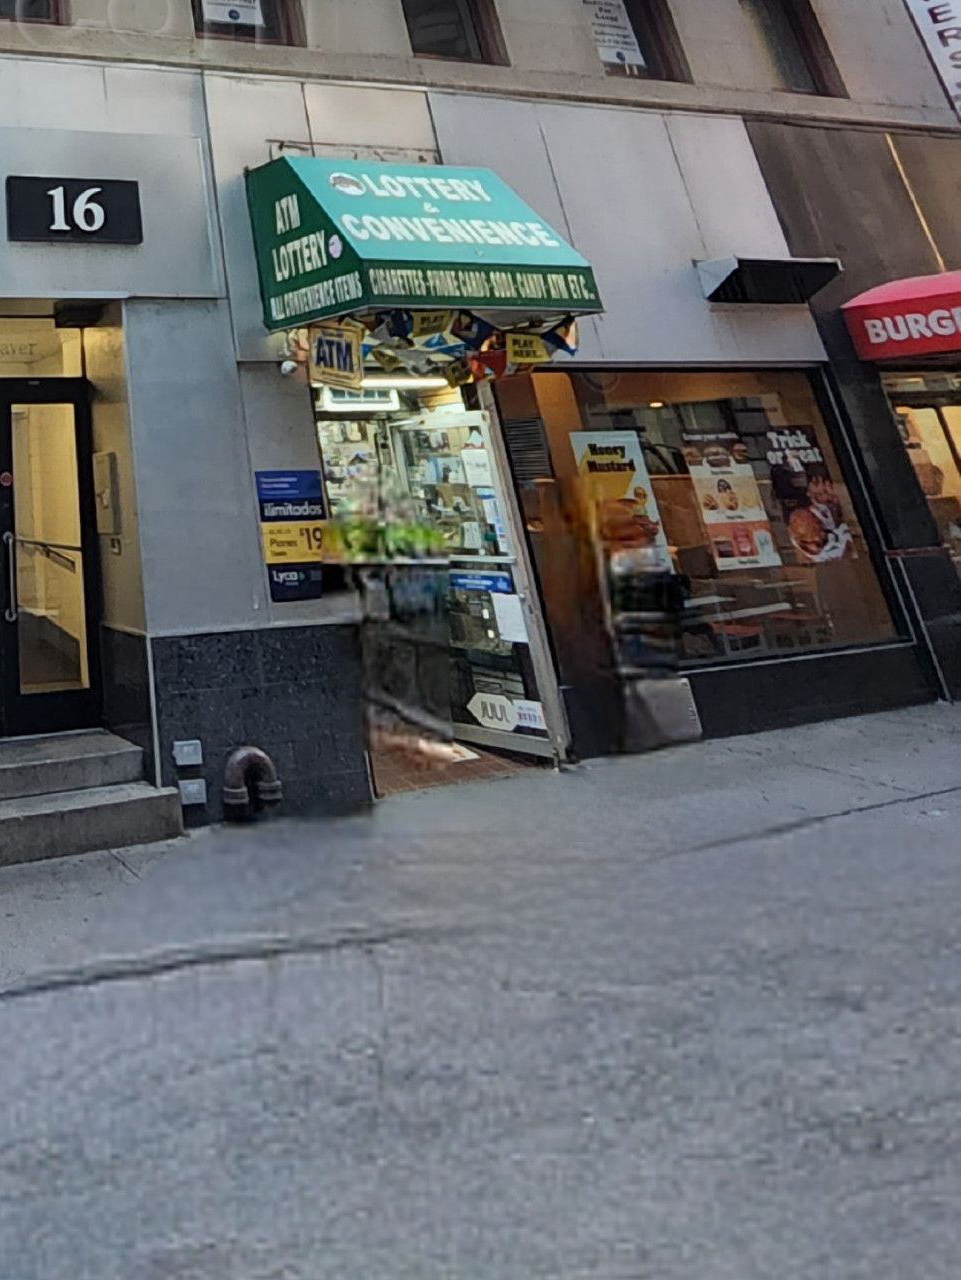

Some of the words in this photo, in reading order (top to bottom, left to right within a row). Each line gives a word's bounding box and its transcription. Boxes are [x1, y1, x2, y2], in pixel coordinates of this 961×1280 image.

[361, 173, 492, 202] LOTTERY
[46, 185, 105, 232] 16
[274, 193, 301, 236] ATM
[423, 201, 440, 213] &
[341, 213, 561, 248] CONVENIENCE
[271, 229, 328, 283] LOTTERY
[333, 271, 363, 303] ITEMS
[315, 336, 354, 372] ATM
[511, 338, 534, 349] PLAY
[587, 443, 626, 459] Honey
[766, 429, 811, 449] Trick
[587, 458, 636, 473] Mustard
[766, 450, 784, 465] or
